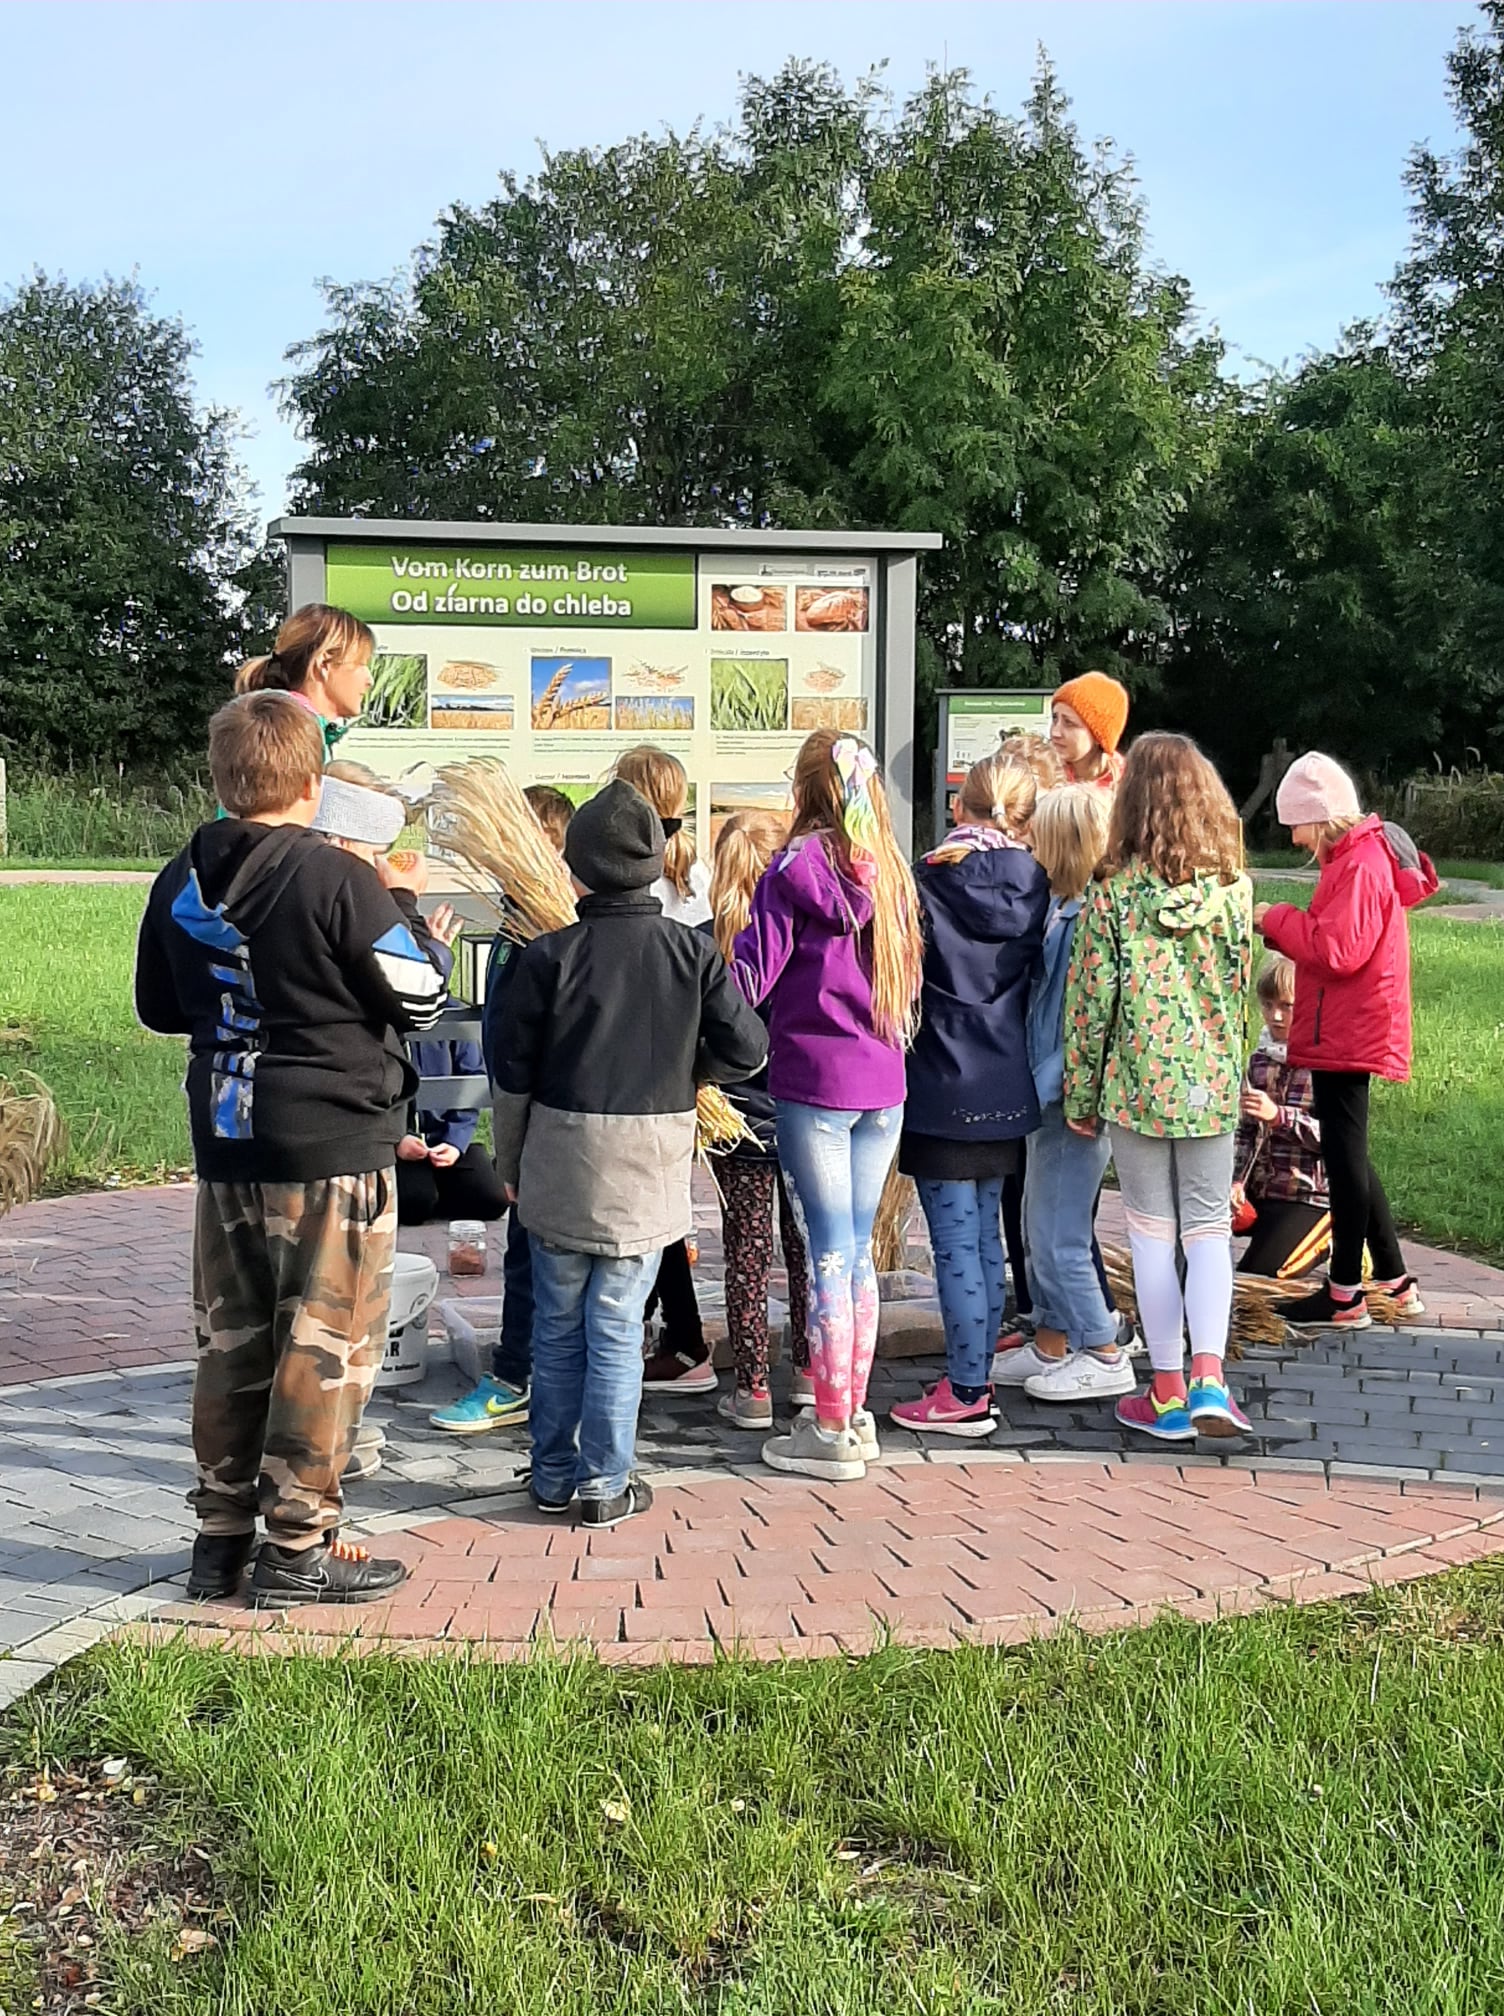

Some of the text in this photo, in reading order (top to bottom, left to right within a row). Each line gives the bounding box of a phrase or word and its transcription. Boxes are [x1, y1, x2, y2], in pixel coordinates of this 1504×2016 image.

[391, 556, 628, 582] Vom Korn zum Brot
[392, 591, 428, 612] Od
[516, 592, 547, 614] do
[553, 593, 631, 616] chleba
